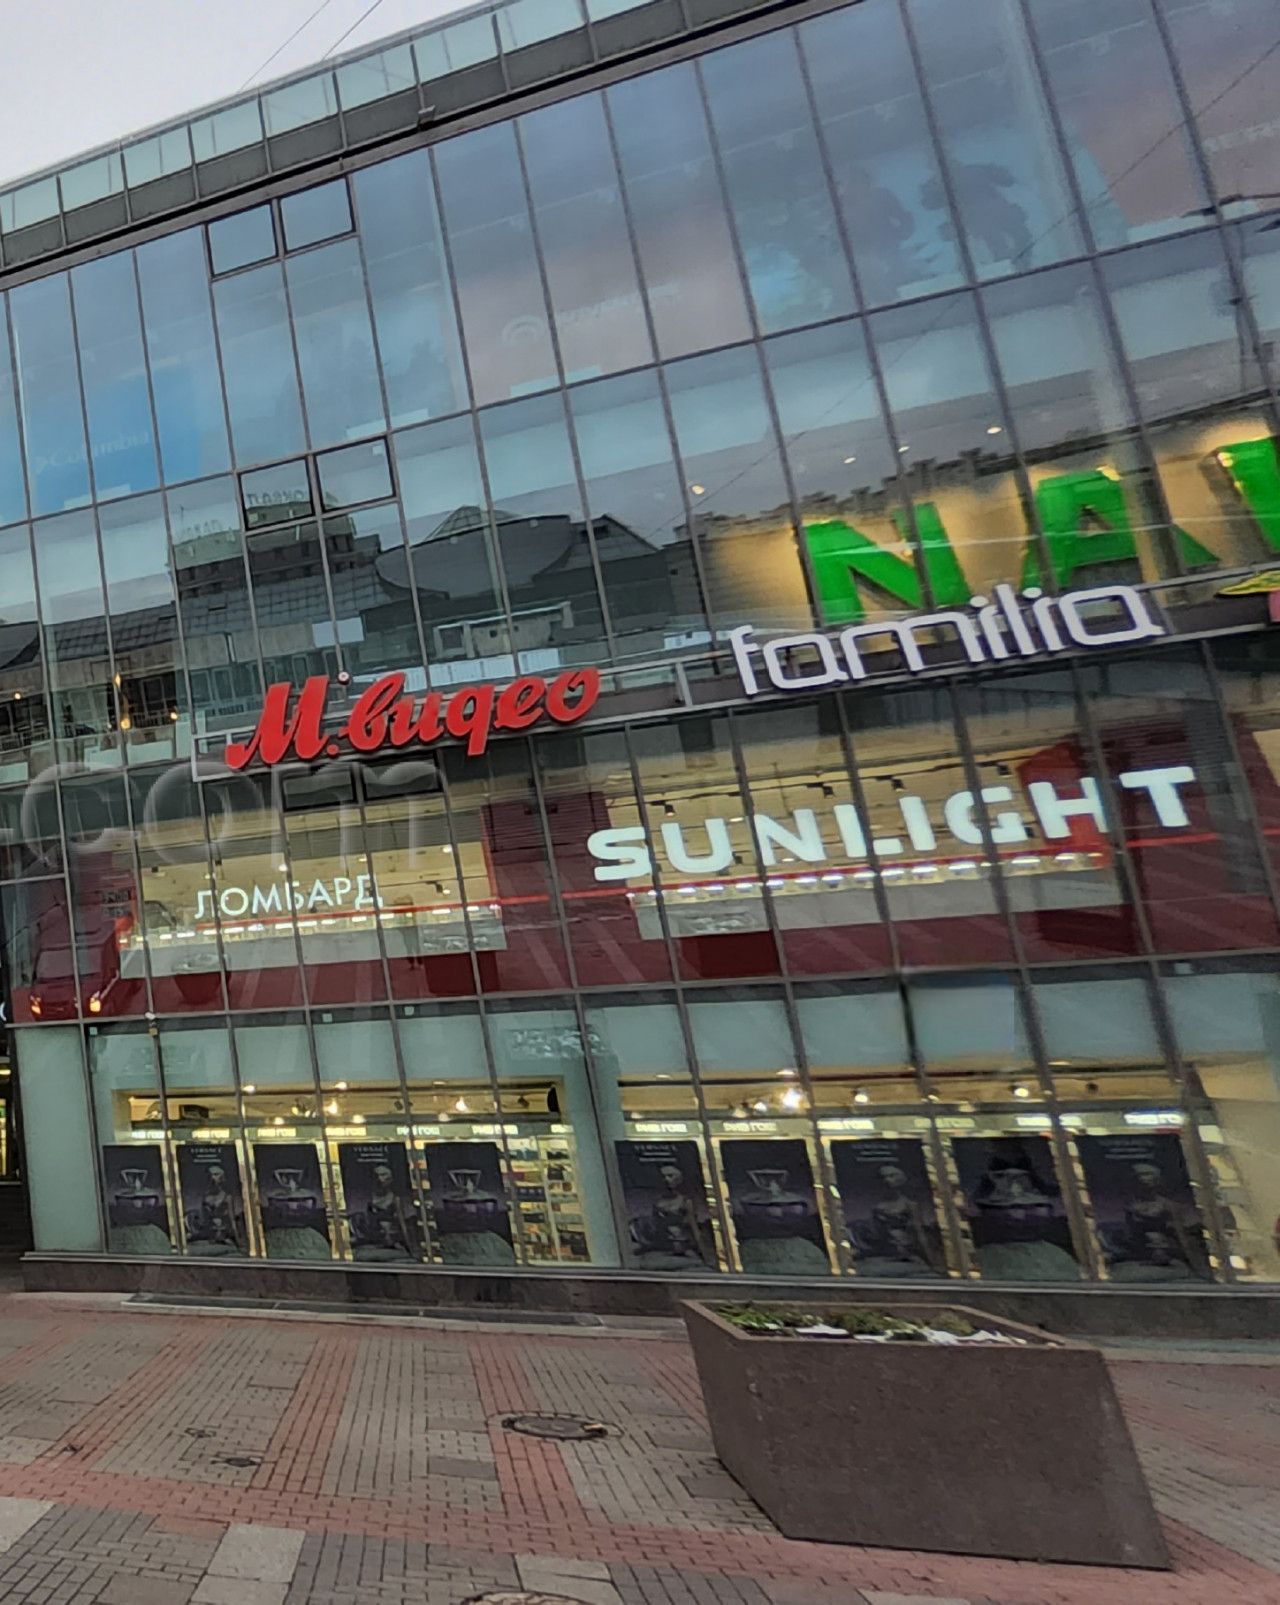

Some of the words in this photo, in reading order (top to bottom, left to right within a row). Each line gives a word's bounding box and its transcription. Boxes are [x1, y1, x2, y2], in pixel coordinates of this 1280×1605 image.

[730, 583, 1164, 696] familia
[225, 667, 601, 771] М.видео
[587, 766, 1197, 883] SUNLIGHT
[194, 873, 385, 920] ЛОМБАРД
